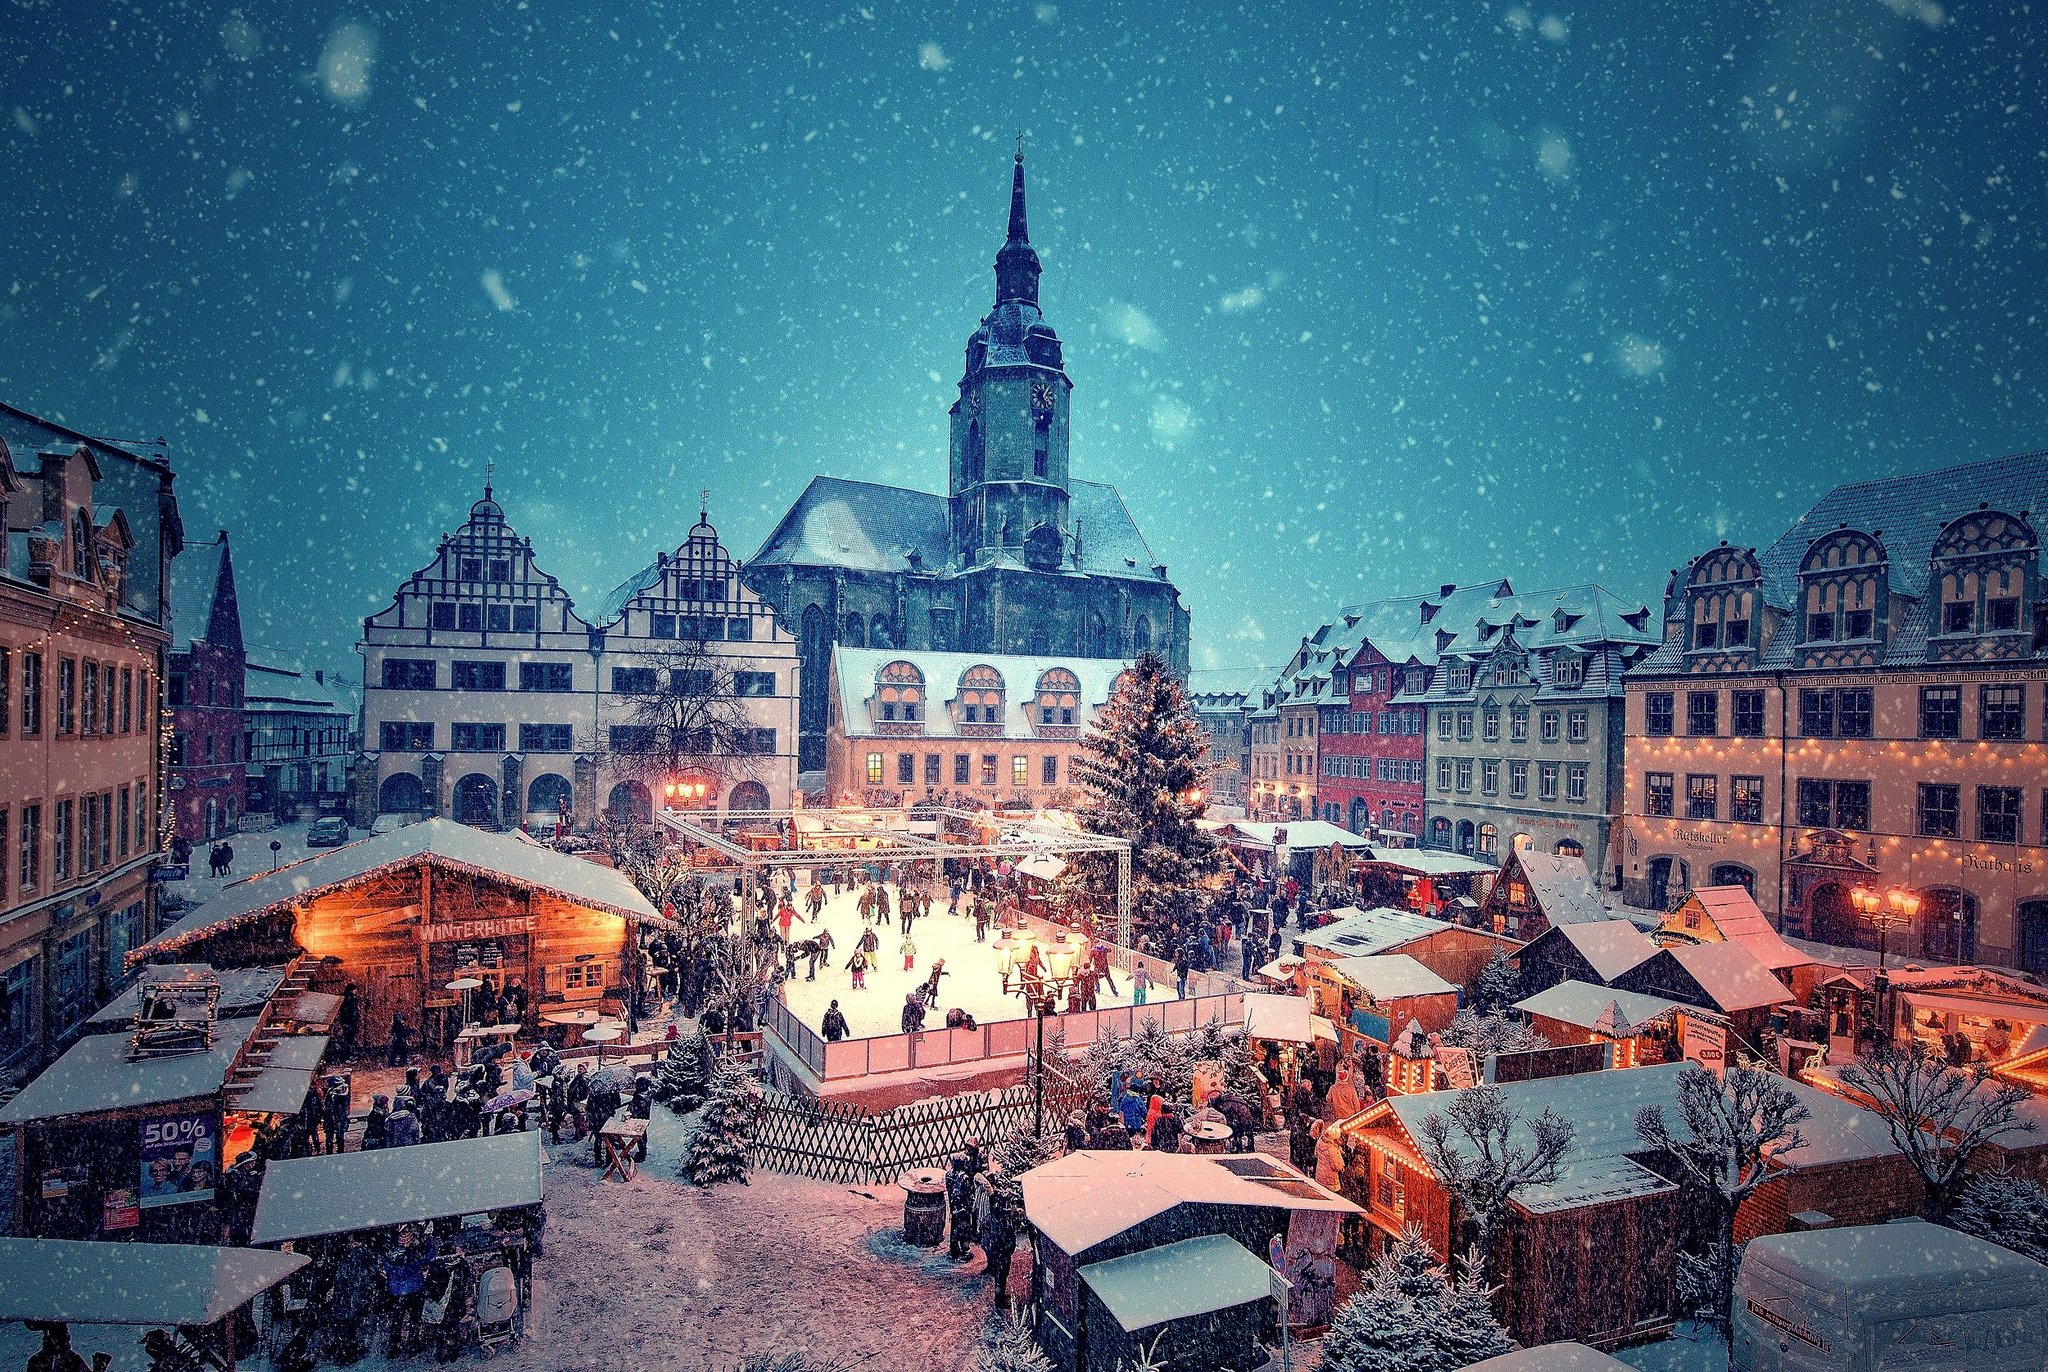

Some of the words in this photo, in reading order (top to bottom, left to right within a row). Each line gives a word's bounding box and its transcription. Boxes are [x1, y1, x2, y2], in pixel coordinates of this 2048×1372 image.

[2003, 671, 2020, 680] des
[971, 788, 1003, 796] TOURIST
[1672, 828, 1728, 845] Ratskeller
[1964, 853, 2033, 874] Rathaus
[420, 916, 536, 942] WINTERHÜTTE
[1686, 1021, 1724, 1039] Kartoffelpuffer
[145, 1118, 206, 1143] 50%
